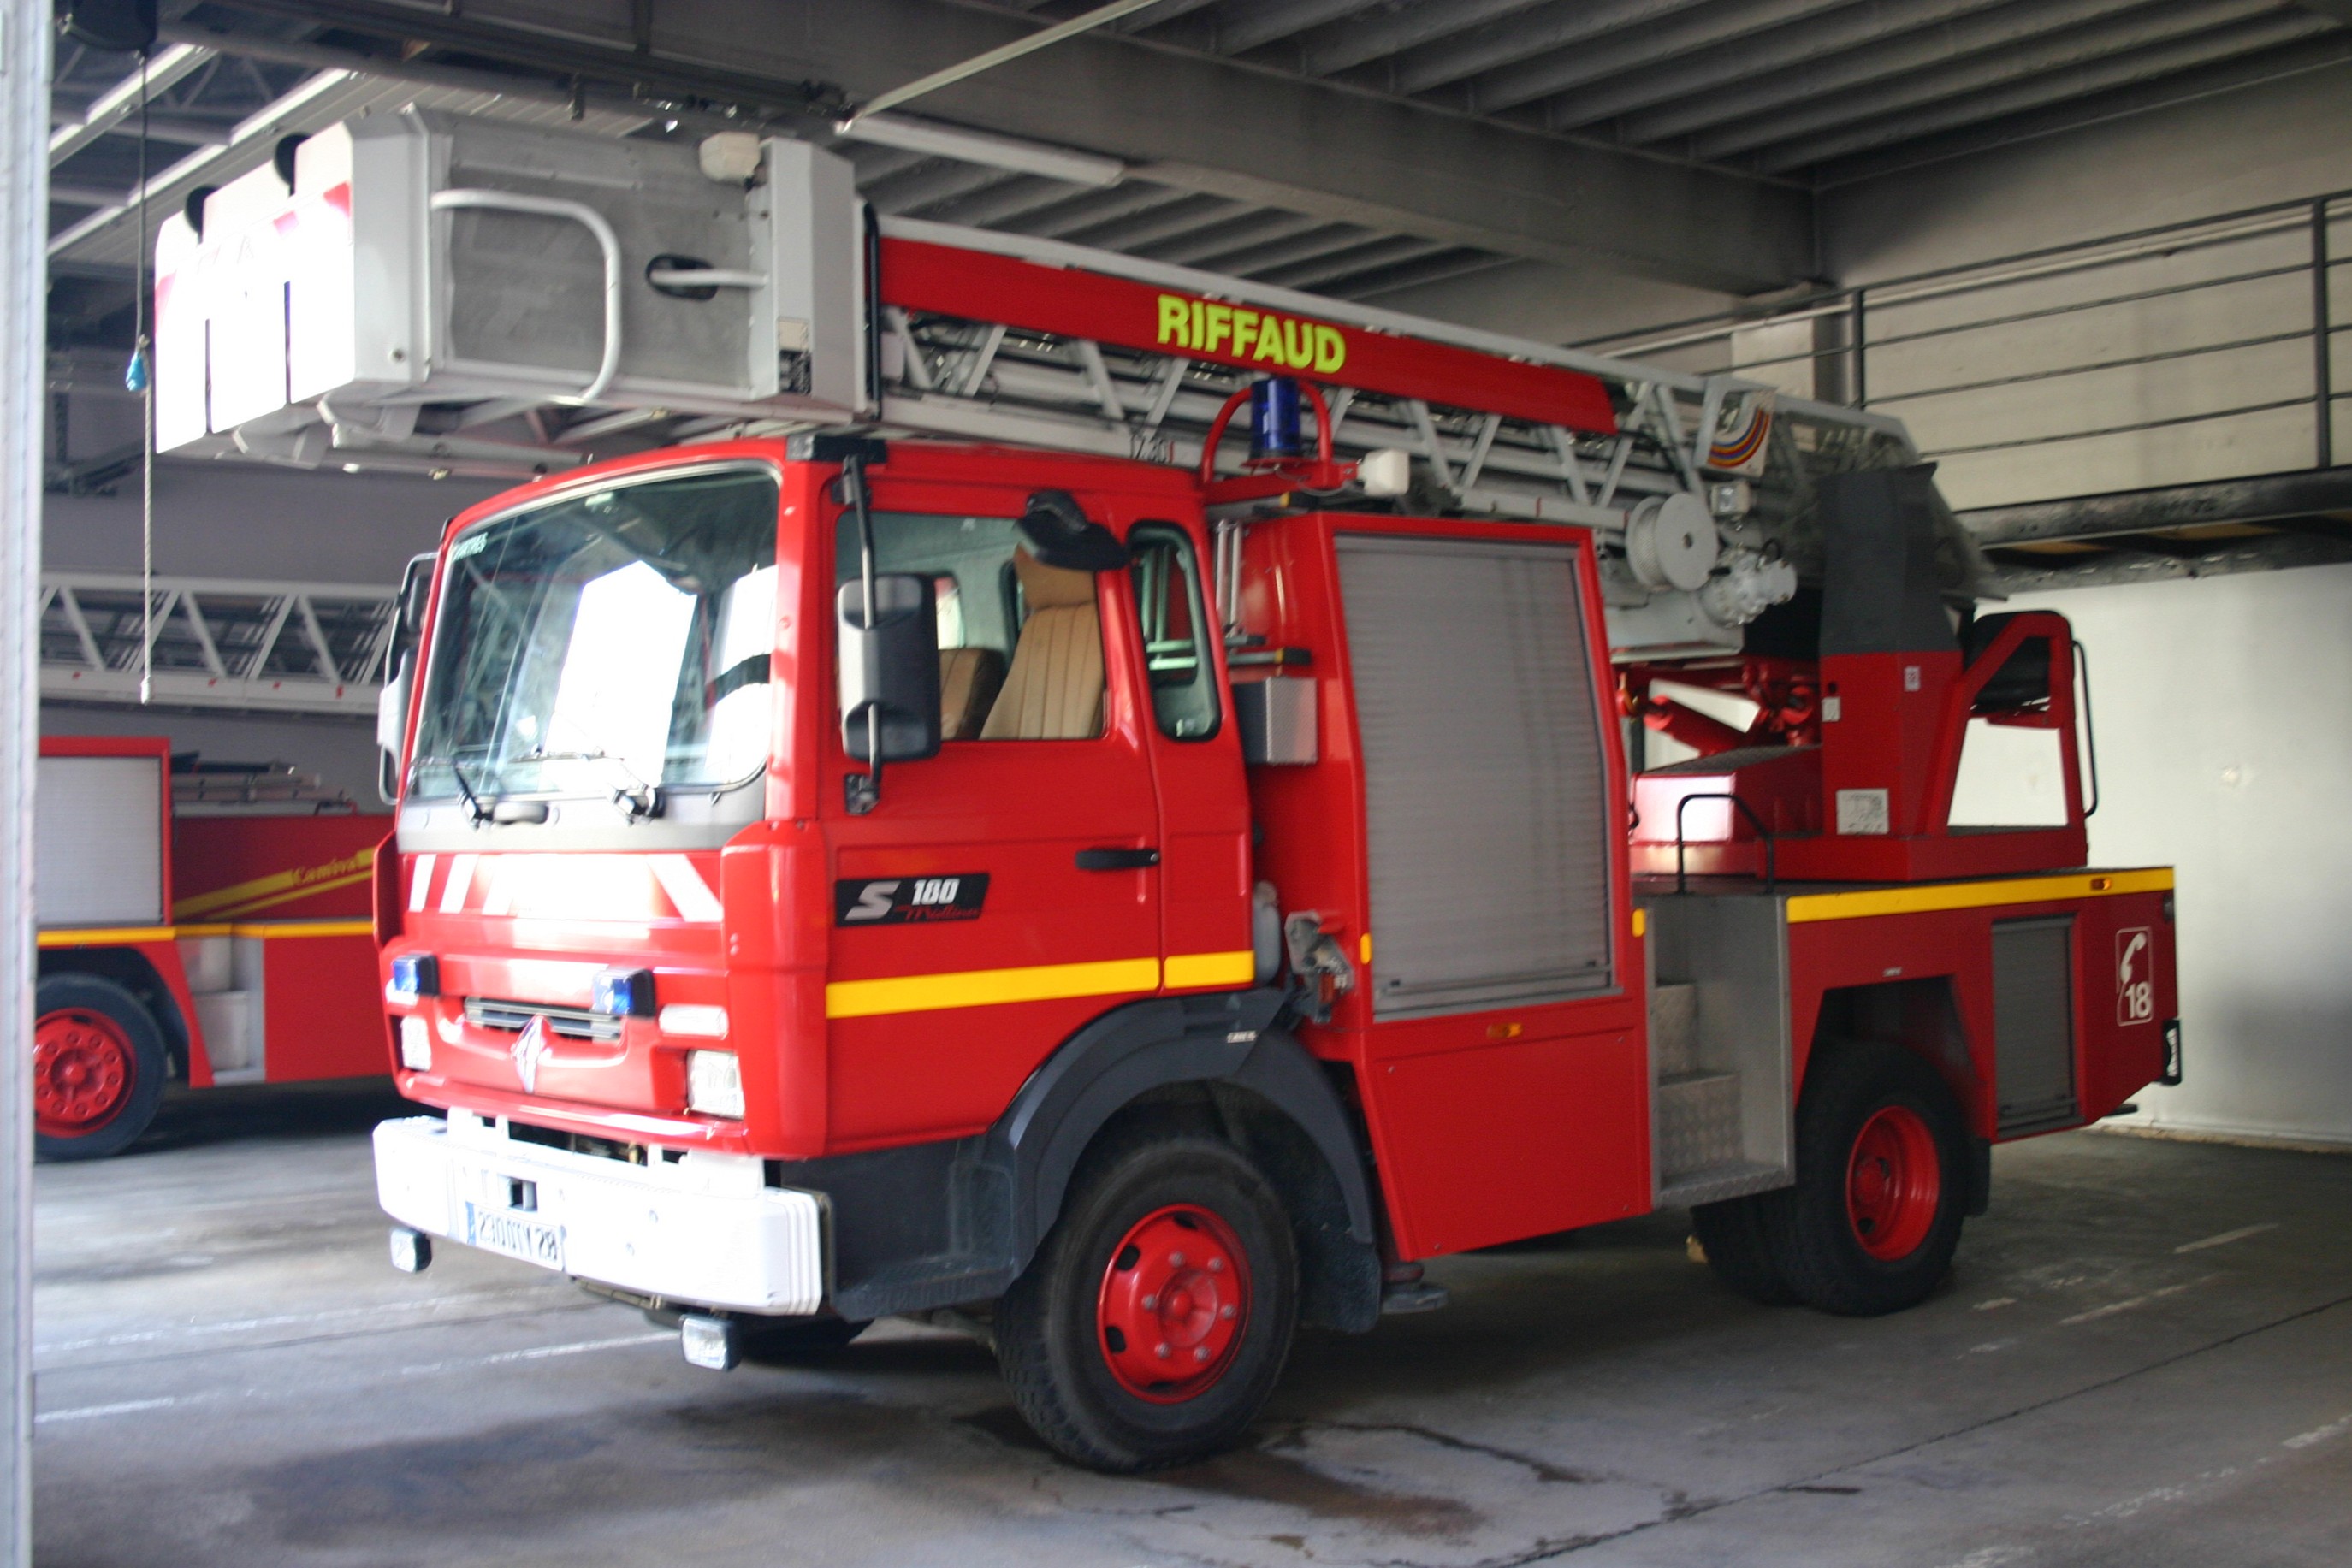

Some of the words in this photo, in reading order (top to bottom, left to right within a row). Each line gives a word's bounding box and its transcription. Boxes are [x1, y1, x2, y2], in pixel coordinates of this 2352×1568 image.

[1157, 293, 1346, 374] RIFFAUD
[844, 880, 901, 921] S
[911, 878, 960, 906] 180
[2125, 981, 2152, 1018] 18
